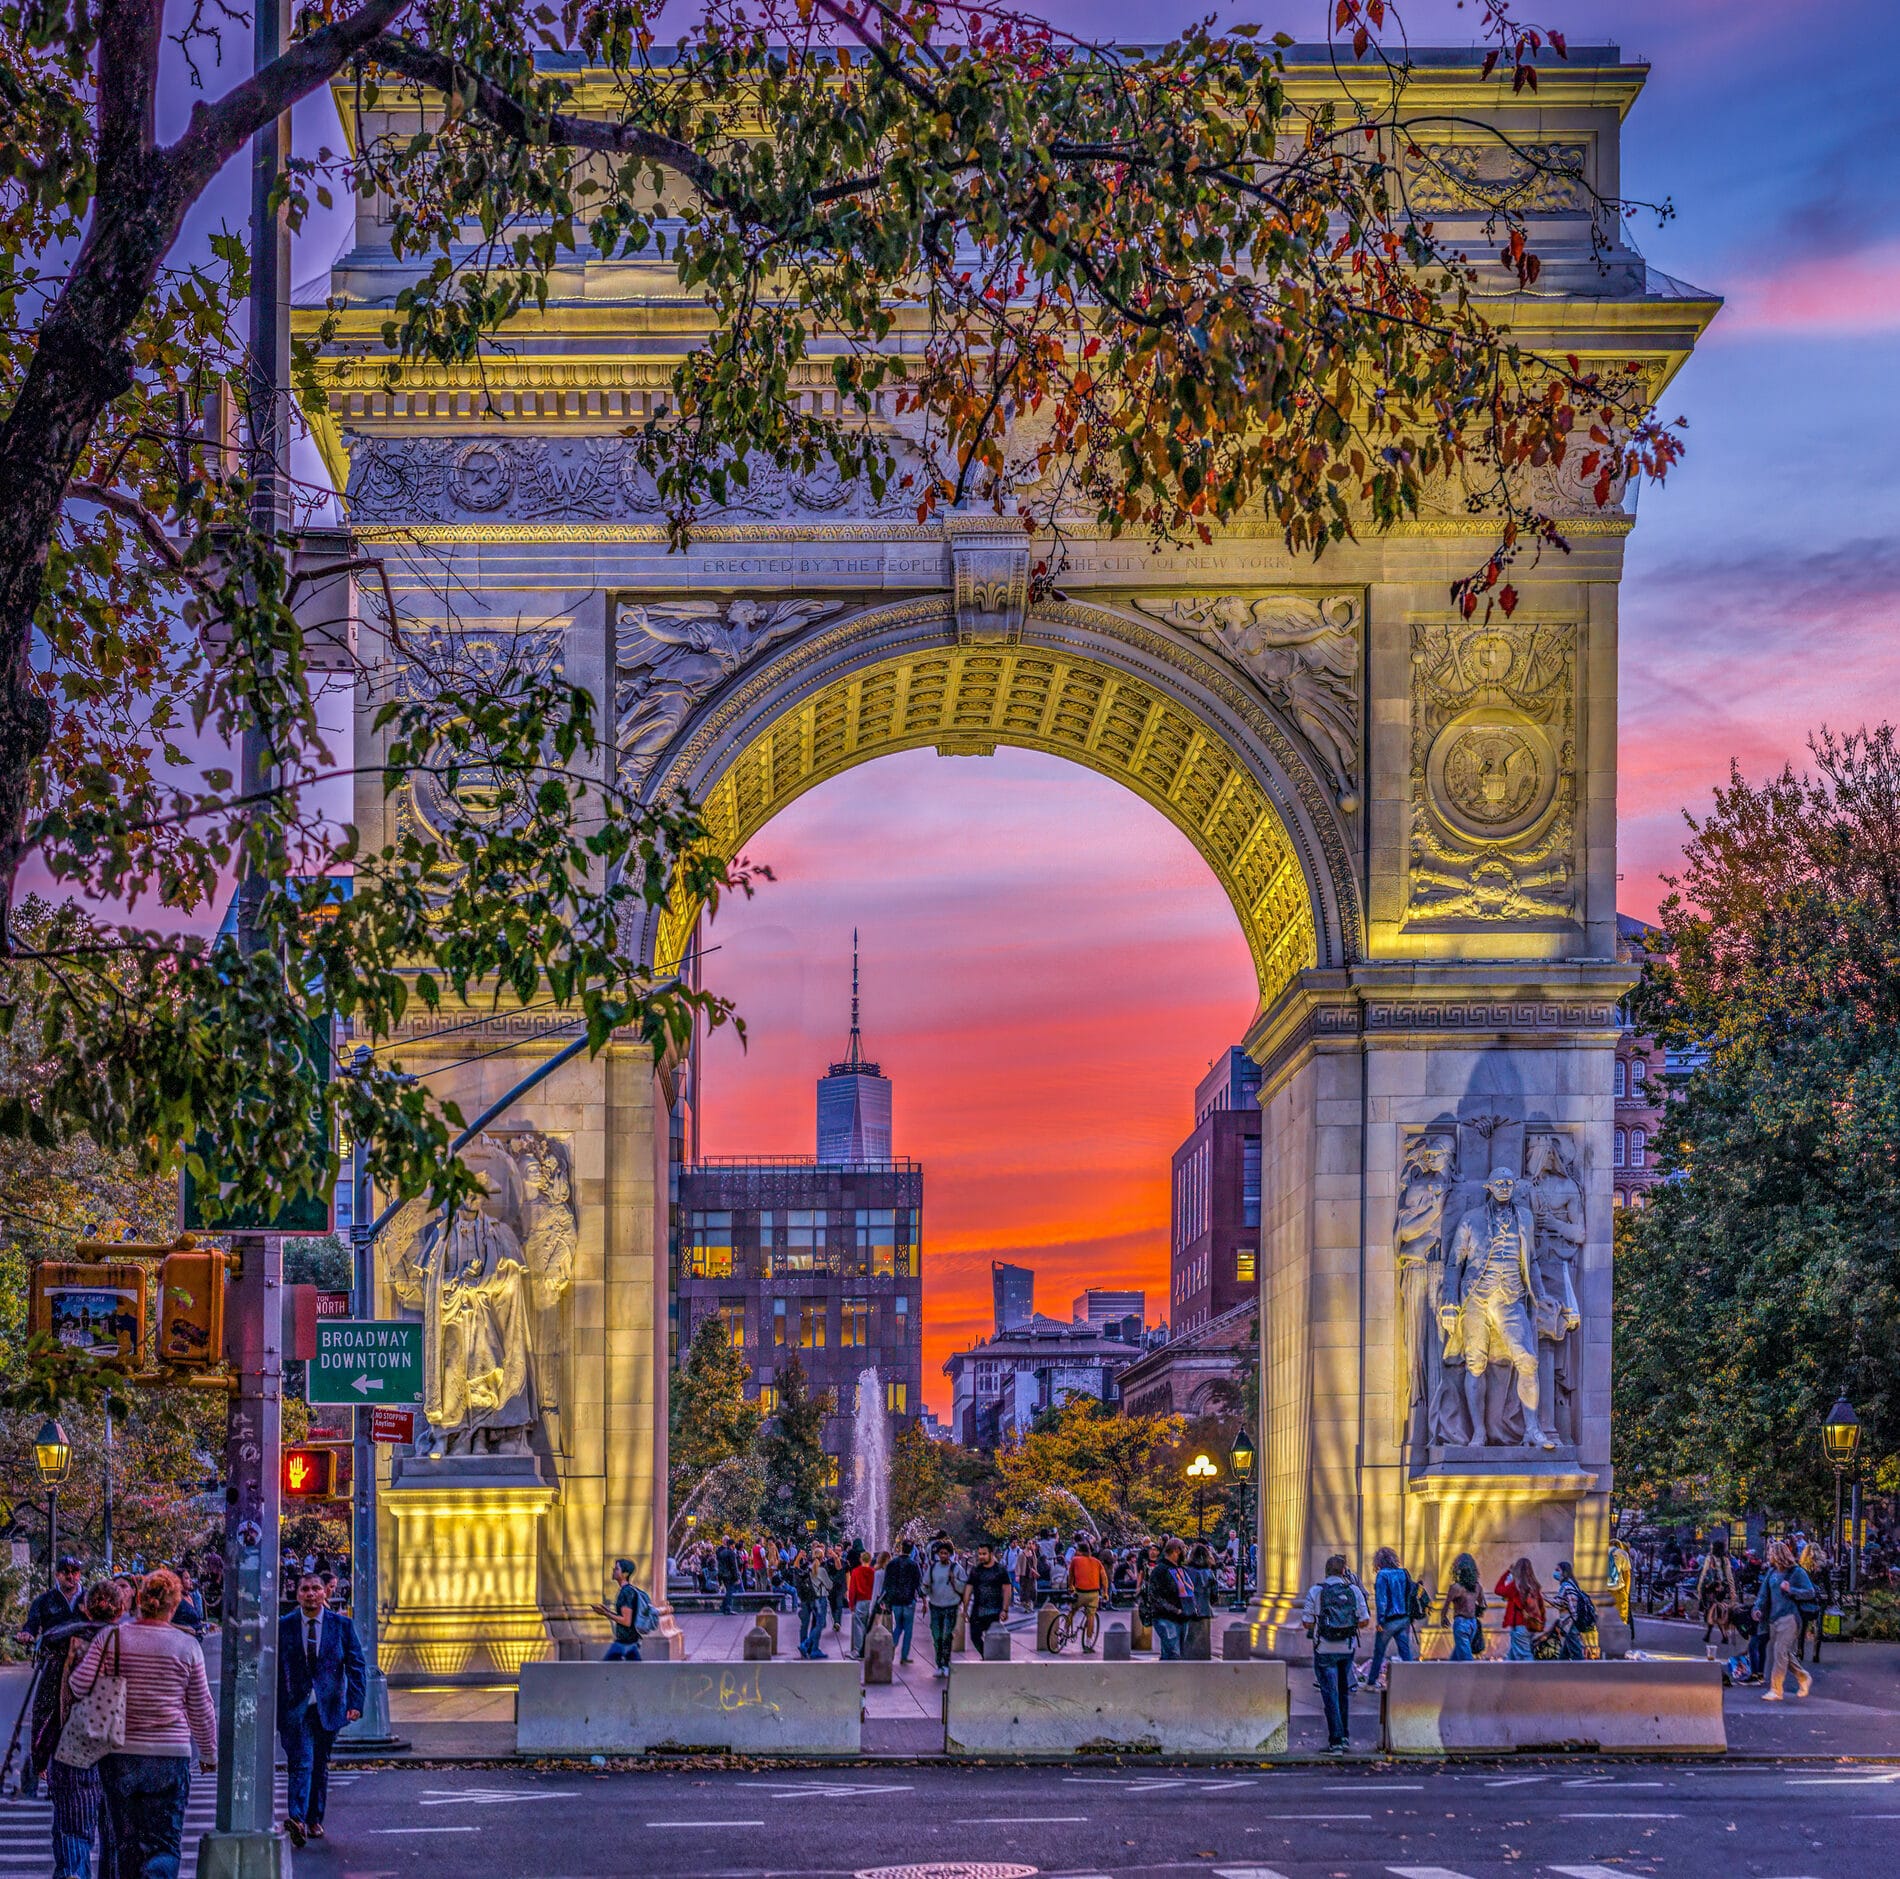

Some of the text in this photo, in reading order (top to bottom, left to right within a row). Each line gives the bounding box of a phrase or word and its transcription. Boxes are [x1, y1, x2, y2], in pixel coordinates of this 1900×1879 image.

[703, 559, 945, 573] ERECTED BY THE PEOPLE
[1104, 557, 1147, 570] CITY
[1187, 557, 1228, 570] NEW
[316, 1301, 345, 1314] NORTH
[322, 1331, 408, 1347] BROADWAY
[321, 1353, 411, 1368] DOWNTOWN
